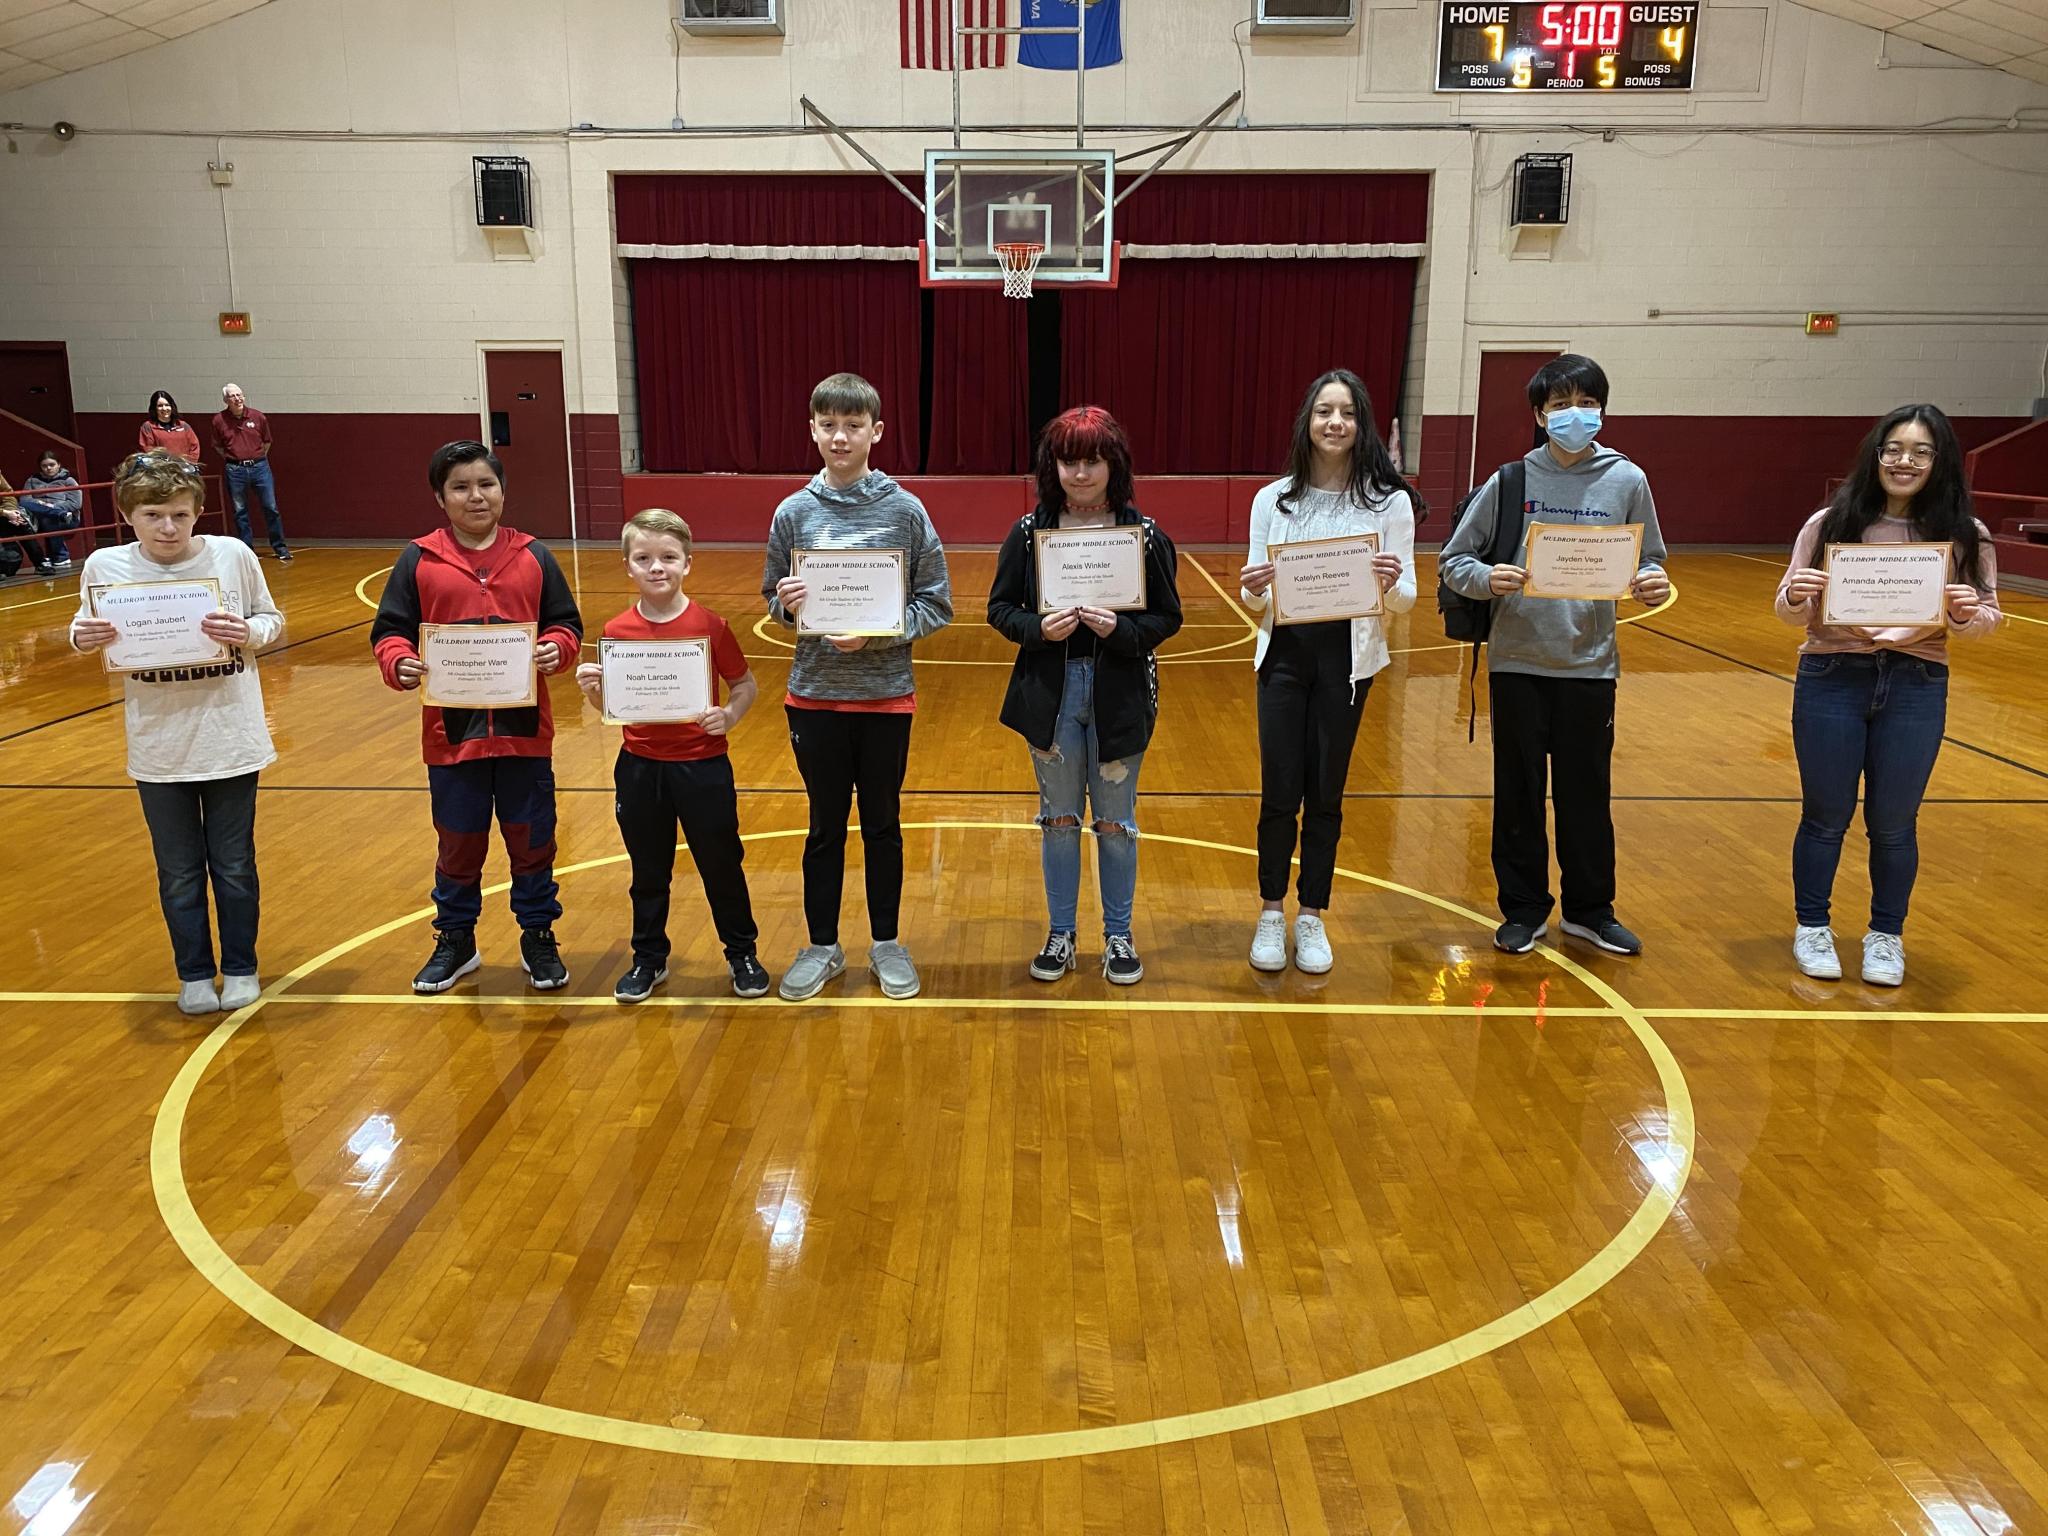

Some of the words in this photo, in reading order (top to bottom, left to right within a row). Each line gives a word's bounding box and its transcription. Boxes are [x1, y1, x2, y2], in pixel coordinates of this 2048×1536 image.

[1450, 6, 1509, 23] HOME
[1629, 6, 1695, 23] GUEST
[1542, 4, 1623, 46] 5:00
[1484, 25, 1504, 63] 7
[1663, 26, 1685, 62] 4
[1461, 64, 1489, 74] POSS
[1566, 51, 1575, 79] 1
[1643, 64, 1671, 74] POSS
[1598, 55, 1616, 87] 5
[1470, 77, 1506, 87] BONUS
[1546, 78, 1584, 88] PERIOD
[1625, 77, 1661, 87] BONUS
[1524, 500, 1611, 520] Champion
[1556, 555, 1582, 563] Jayden
[1584, 556, 1603, 564] Vega
[1294, 574, 1321, 583] Katelyn
[1842, 577, 1875, 585] Amanda
[1877, 577, 1923, 586] Aphonexay
[822, 584, 840, 592] Jace
[841, 584, 869, 592] Prewett
[180, 591, 209, 600] SCHOOL
[125, 619, 153, 628] Logan
[155, 615, 186, 625] Jaubert
[441, 659, 486, 668] Christopher
[626, 673, 646, 681] Noah
[647, 673, 678, 681] Larcade
